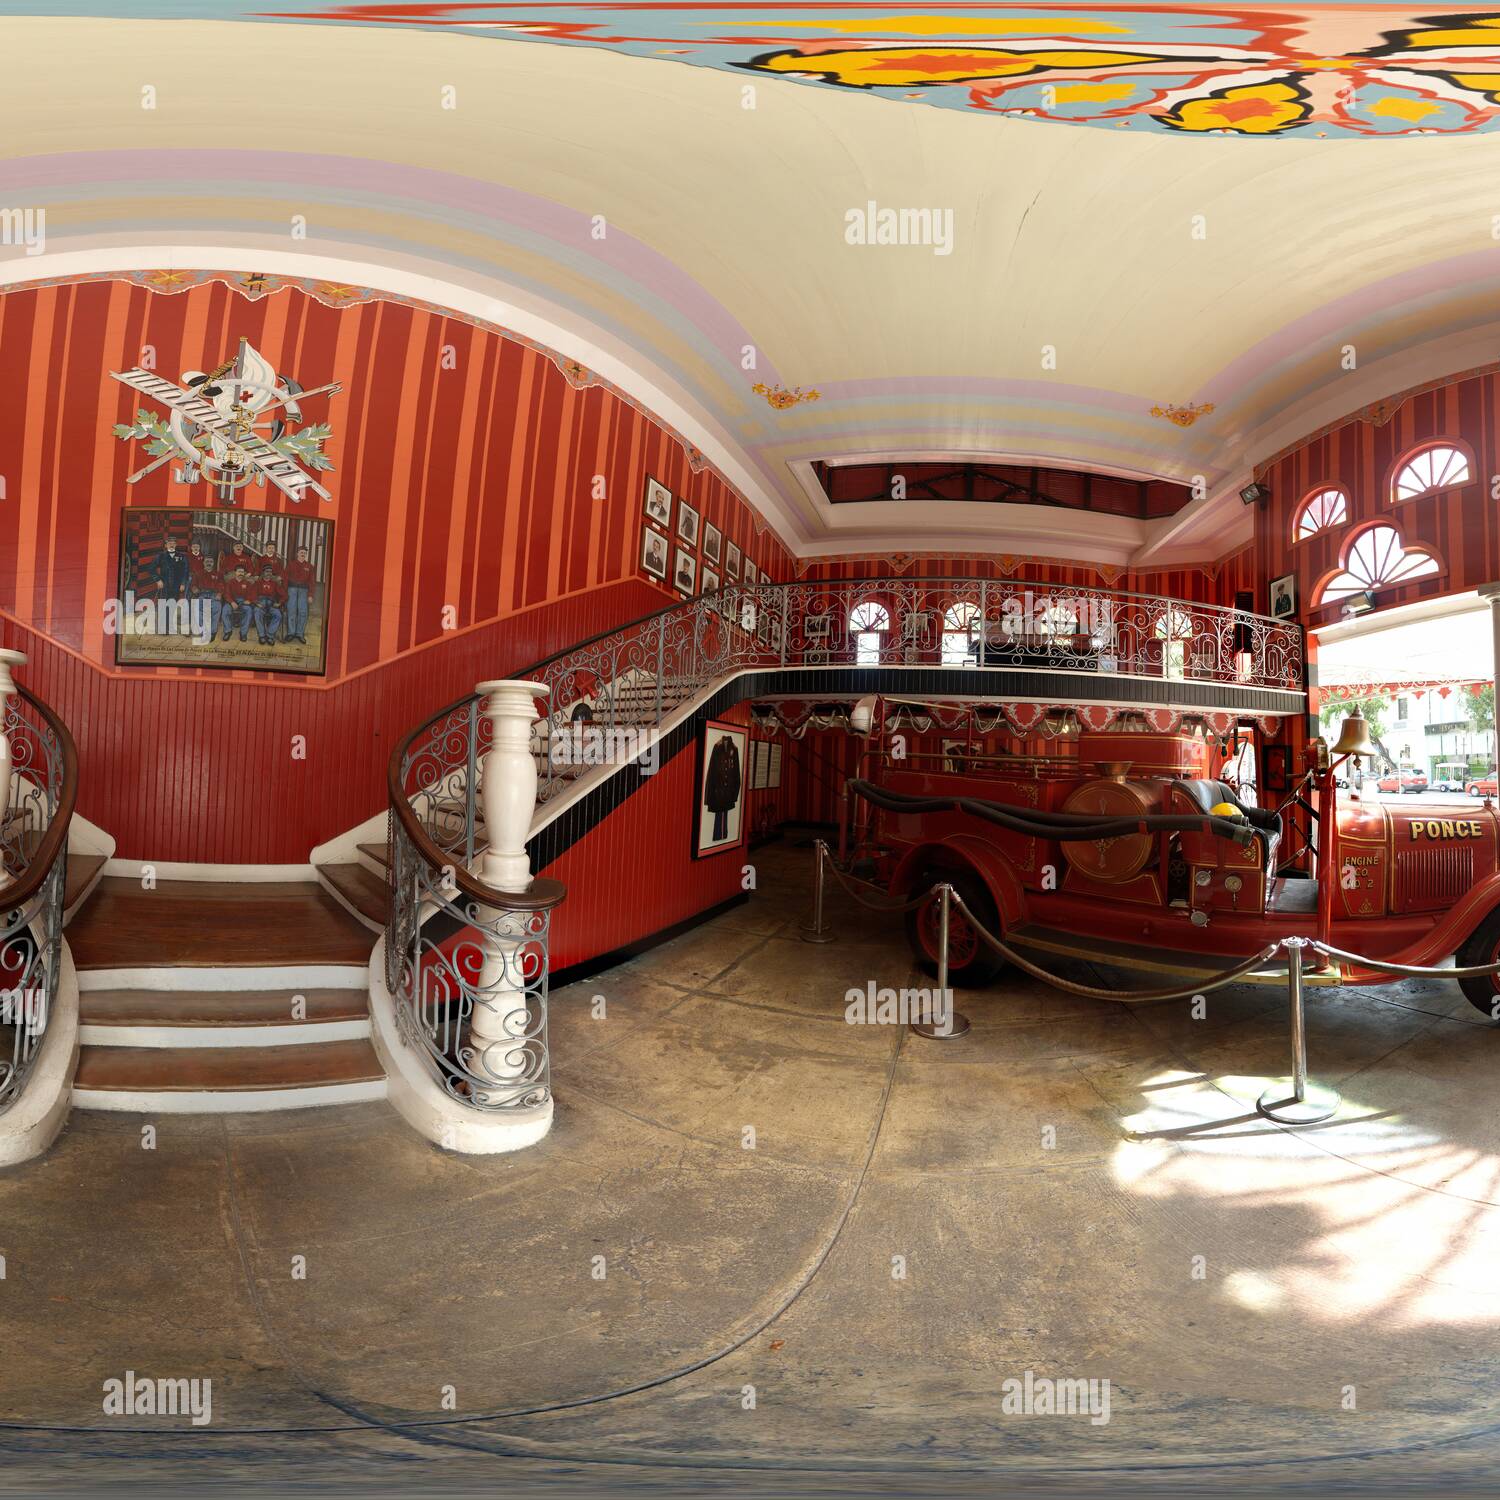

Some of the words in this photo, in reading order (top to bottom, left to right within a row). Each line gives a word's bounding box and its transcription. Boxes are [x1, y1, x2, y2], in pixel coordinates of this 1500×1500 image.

[1410, 820, 1483, 840] PONCE
[1344, 856, 1379, 866] ENGINE
[1368, 879, 1374, 888] 2
